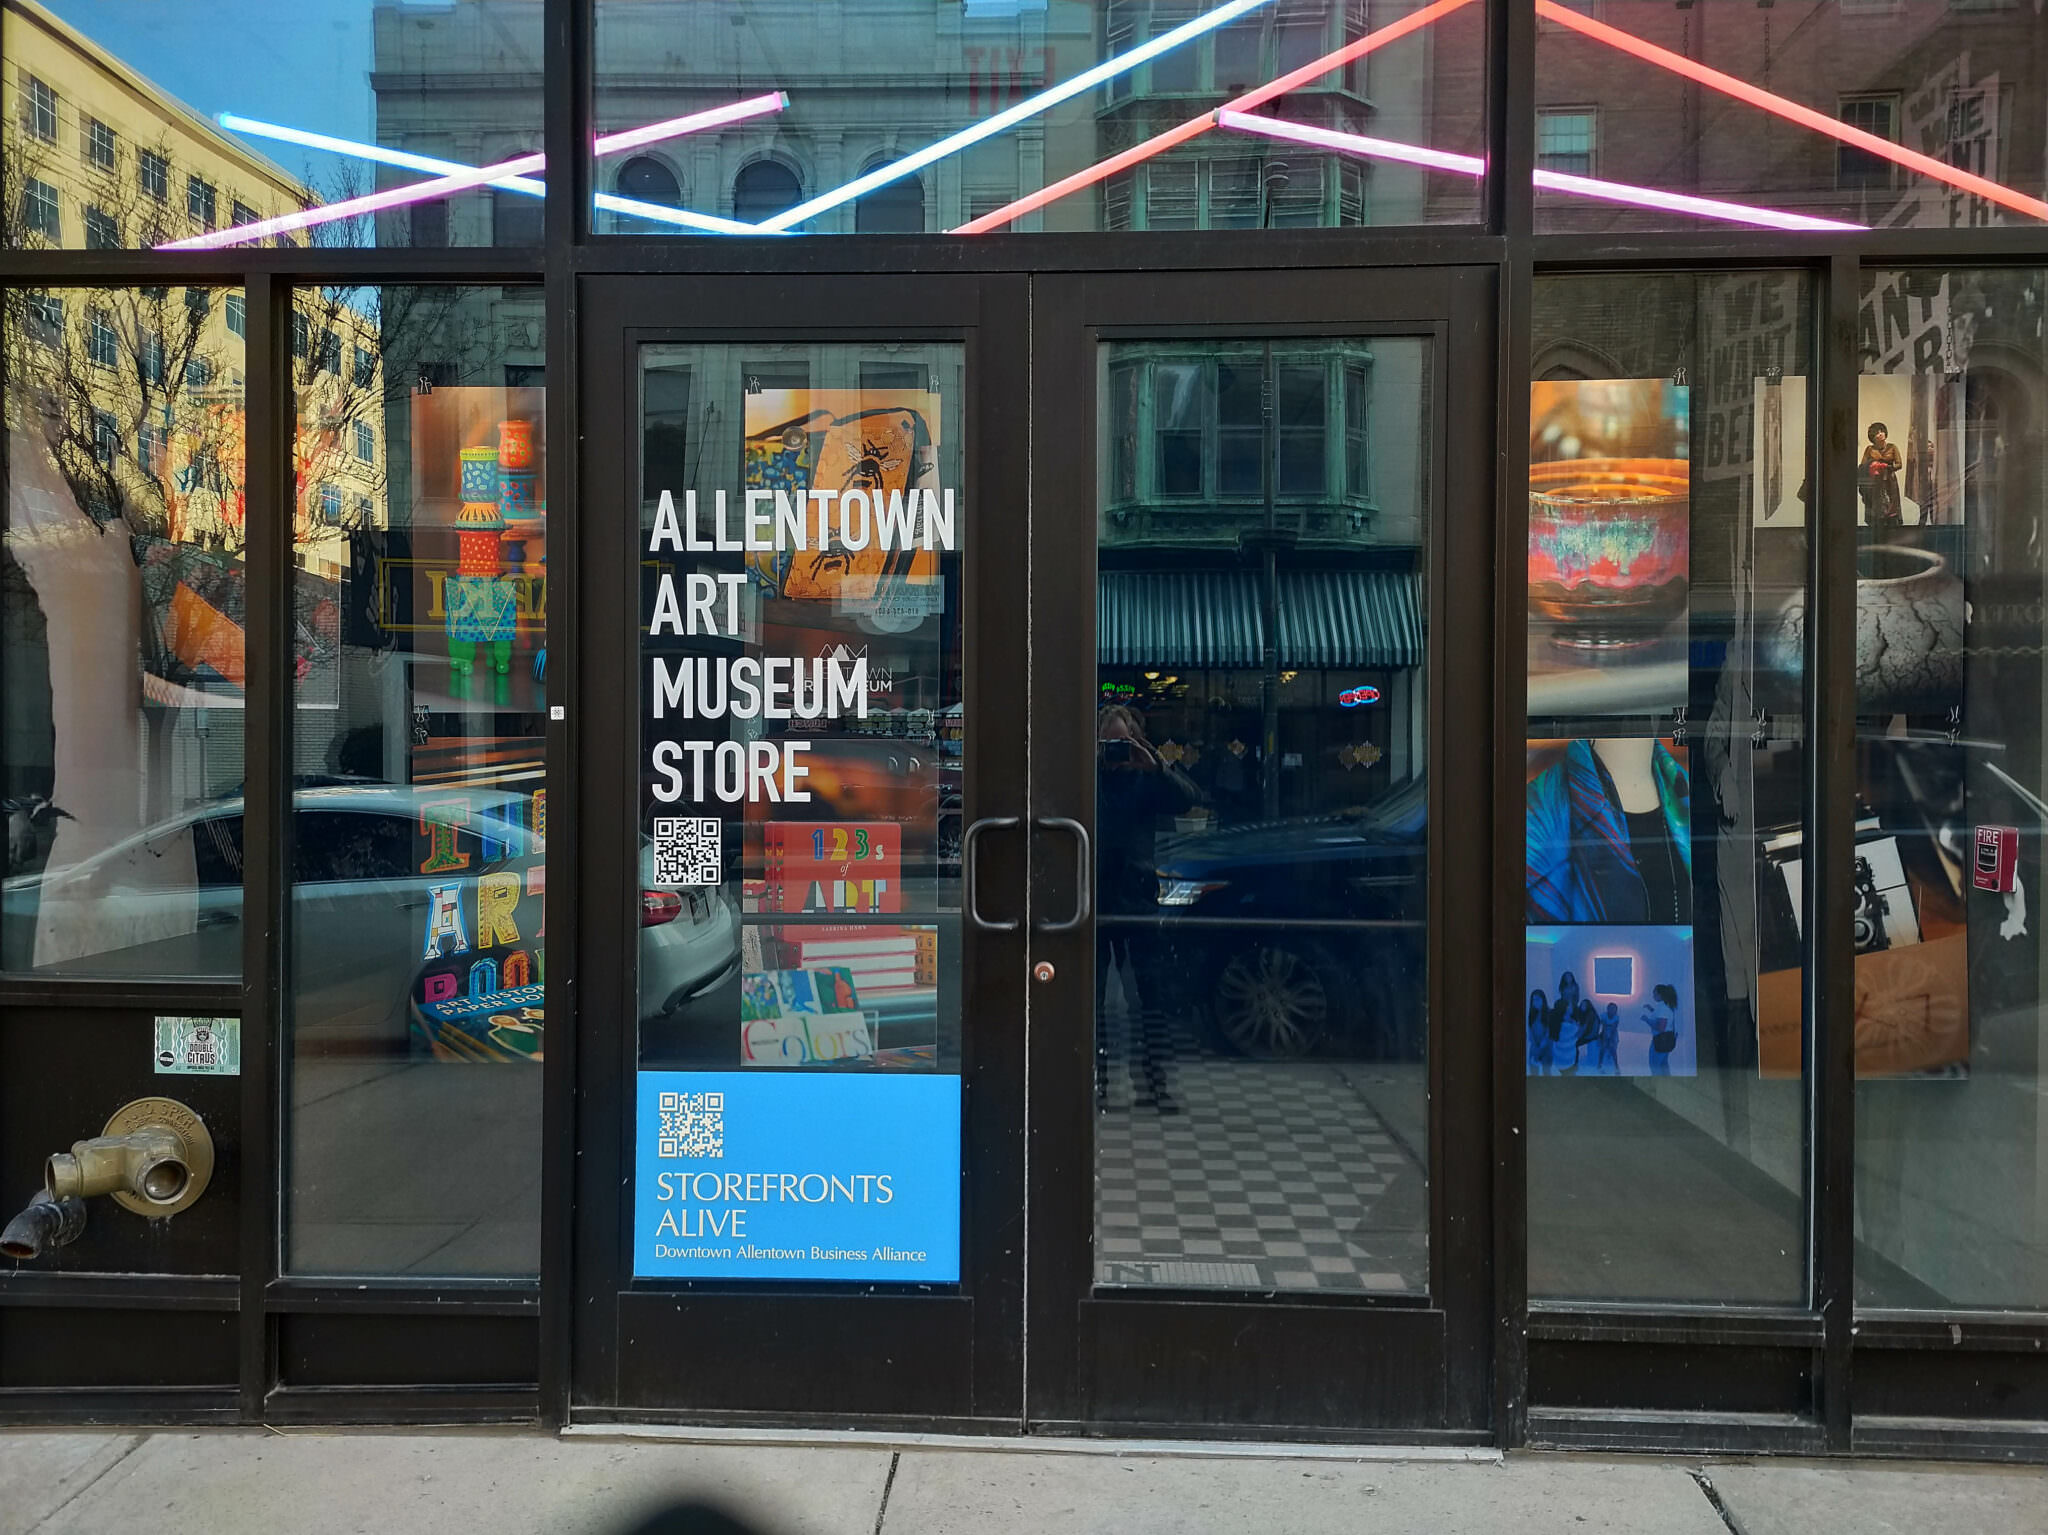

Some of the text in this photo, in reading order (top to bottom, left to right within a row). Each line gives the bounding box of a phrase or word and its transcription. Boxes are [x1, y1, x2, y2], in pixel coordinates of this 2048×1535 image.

[649, 488, 955, 552] ALLENTOWN
[649, 573, 747, 636] ART
[653, 657, 868, 719] MUSEUM
[651, 740, 812, 803] STORE
[1977, 828, 1999, 844] FIRE
[840, 862, 852, 876] of
[801, 880, 888, 914] ART
[435, 998, 472, 1010] ART
[441, 1000, 508, 1016] PAPER
[189, 1043, 213, 1052] DOUBLE
[742, 1016, 870, 1063] Colors
[187, 1053, 215, 1065] CITRUS
[656, 1172, 893, 1204] STOREFRONTS
[655, 1209, 747, 1238] ALIVE
[655, 1244, 927, 1262] Downtown Allentown Business Alliance
